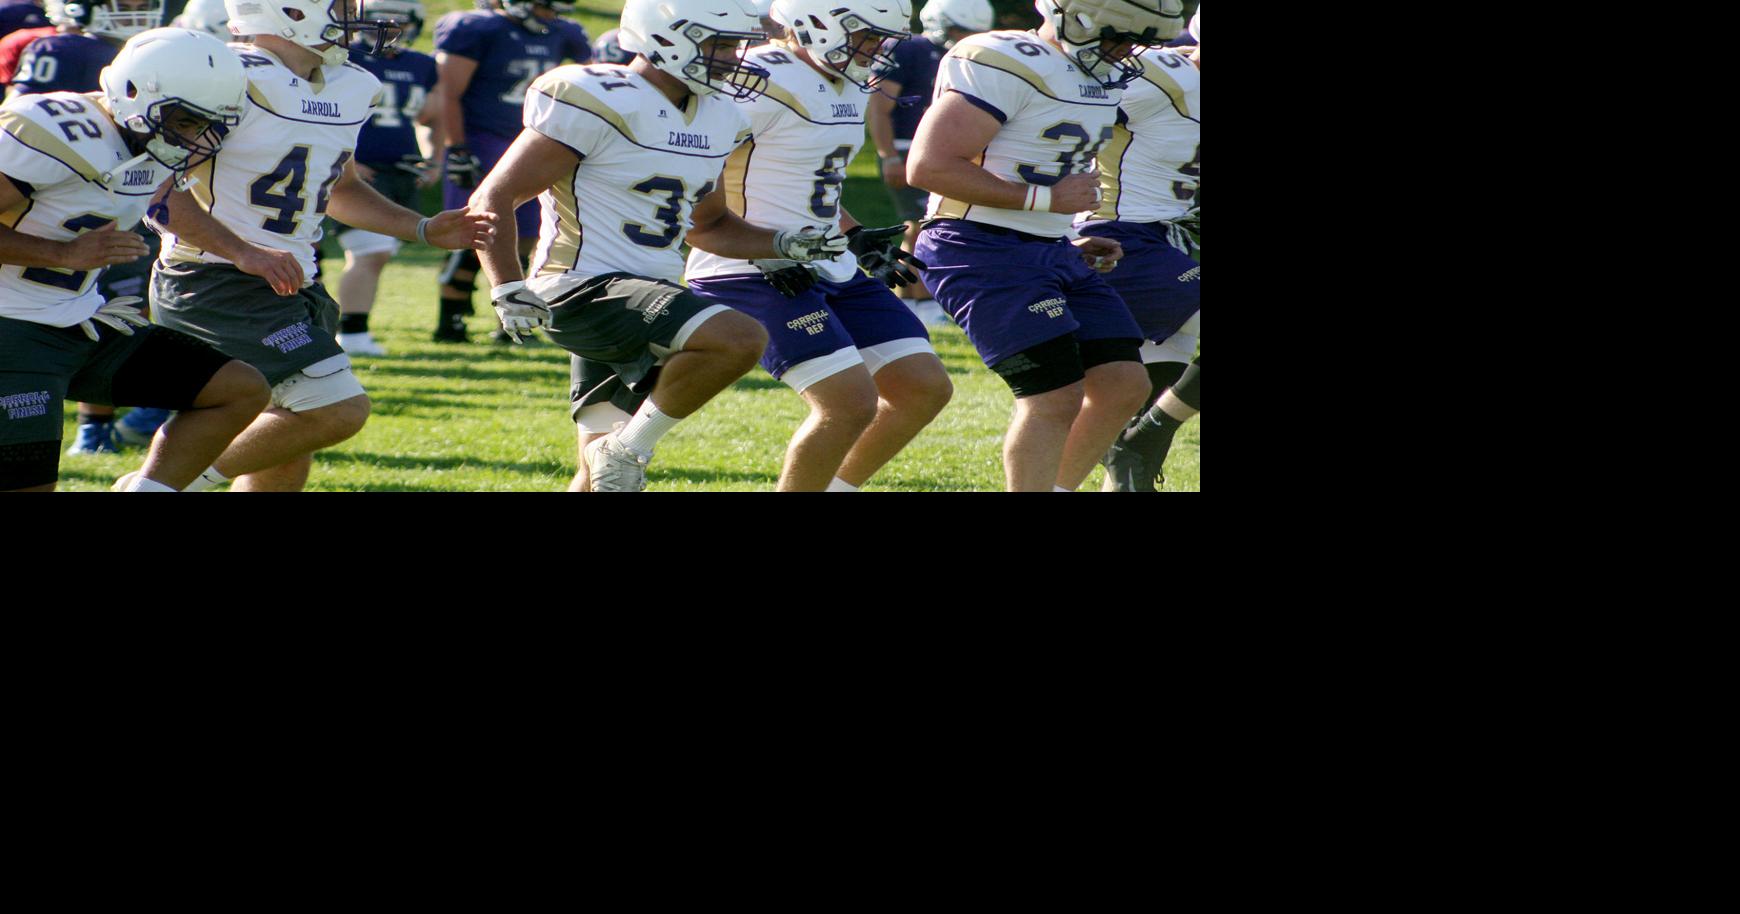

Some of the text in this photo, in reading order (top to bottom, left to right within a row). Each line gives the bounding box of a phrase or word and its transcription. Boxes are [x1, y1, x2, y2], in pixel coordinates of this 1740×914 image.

[301, 99, 341, 118] CARROLL
[37, 98, 103, 142] 22
[667, 131, 711, 150] CARROLL
[122, 170, 155, 186] CARROLL
[1028, 298, 1066, 312] CARROLL
[1046, 307, 1064, 319] REP
[786, 310, 829, 329] CARROLL
[806, 323, 824, 335] REP
